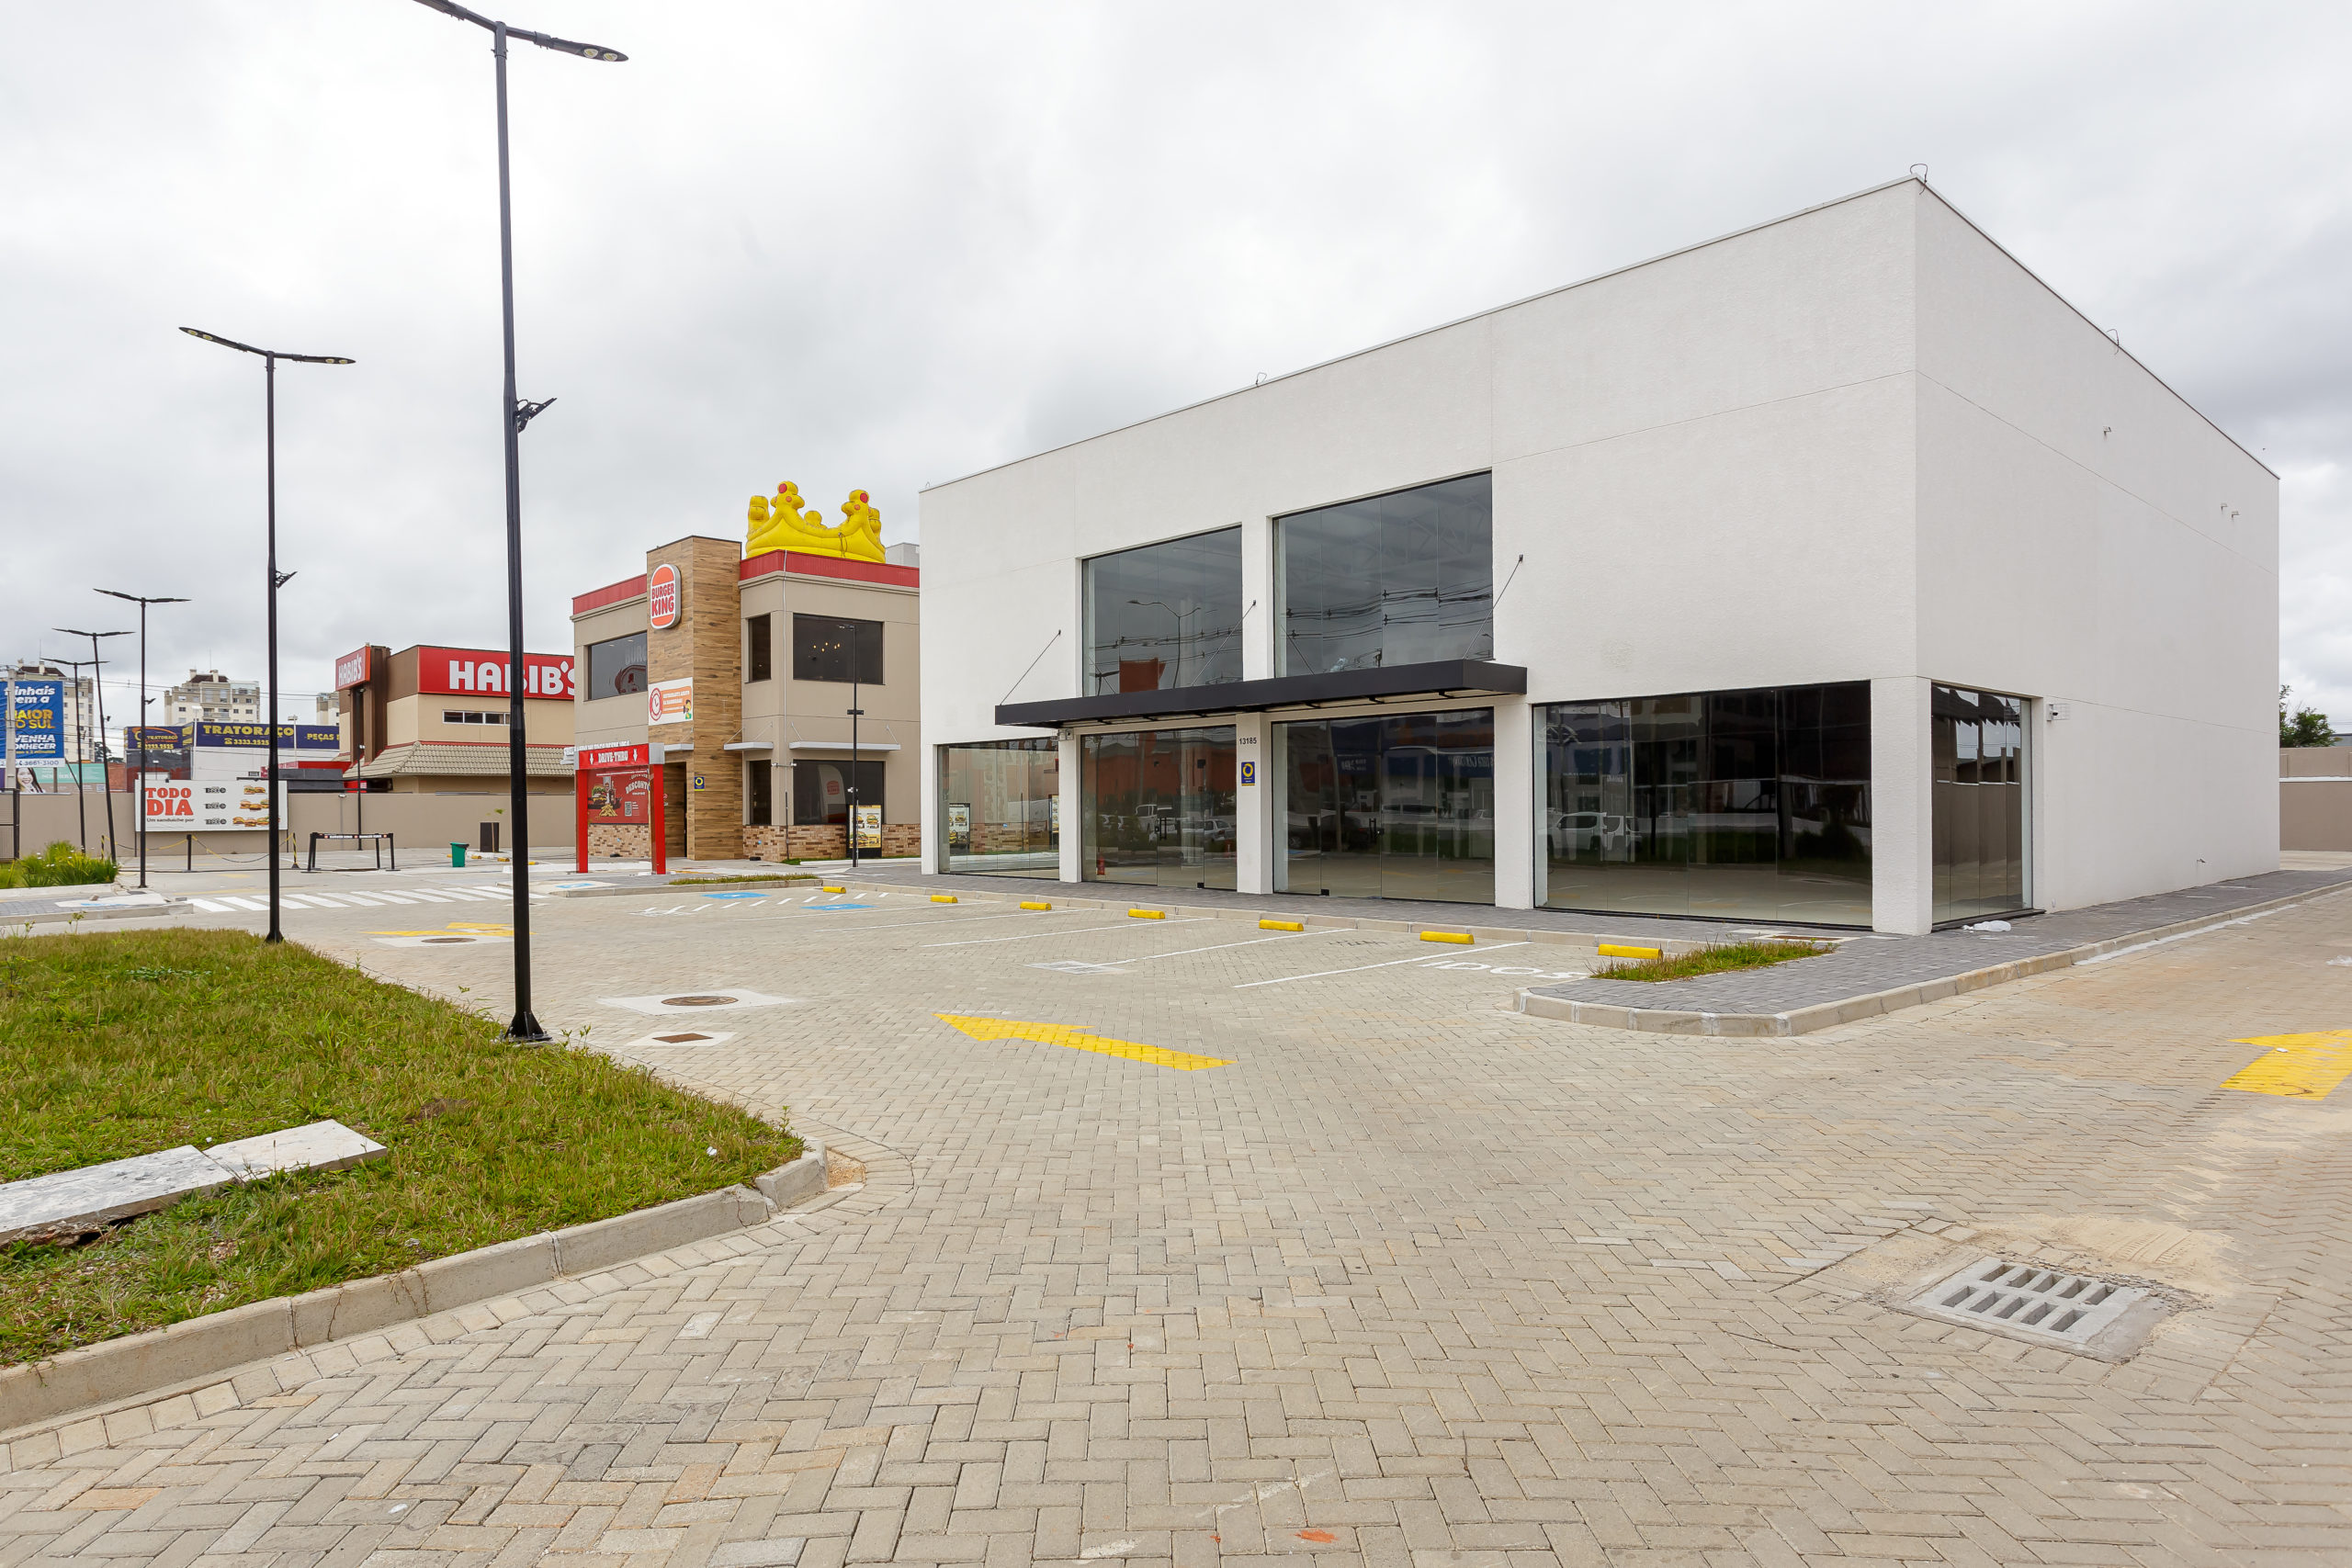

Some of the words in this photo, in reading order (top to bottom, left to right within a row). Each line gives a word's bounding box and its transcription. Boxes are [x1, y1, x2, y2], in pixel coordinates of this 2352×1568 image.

[651, 582, 674, 599] BURGER
[651, 595, 674, 616] KING
[338, 654, 362, 685] HABIB'S
[4, 685, 55, 695] inhais
[15, 696, 37, 705] em
[28, 719, 55, 728] SUL
[307, 733, 334, 741] PEÇAS
[598, 750, 628, 763] DRIVE-THRU
[145, 787, 192, 798] TODO
[626, 781, 650, 794] DESCONT
[147, 799, 194, 816] DIA
[1418, 960, 1589, 979] IDOS
